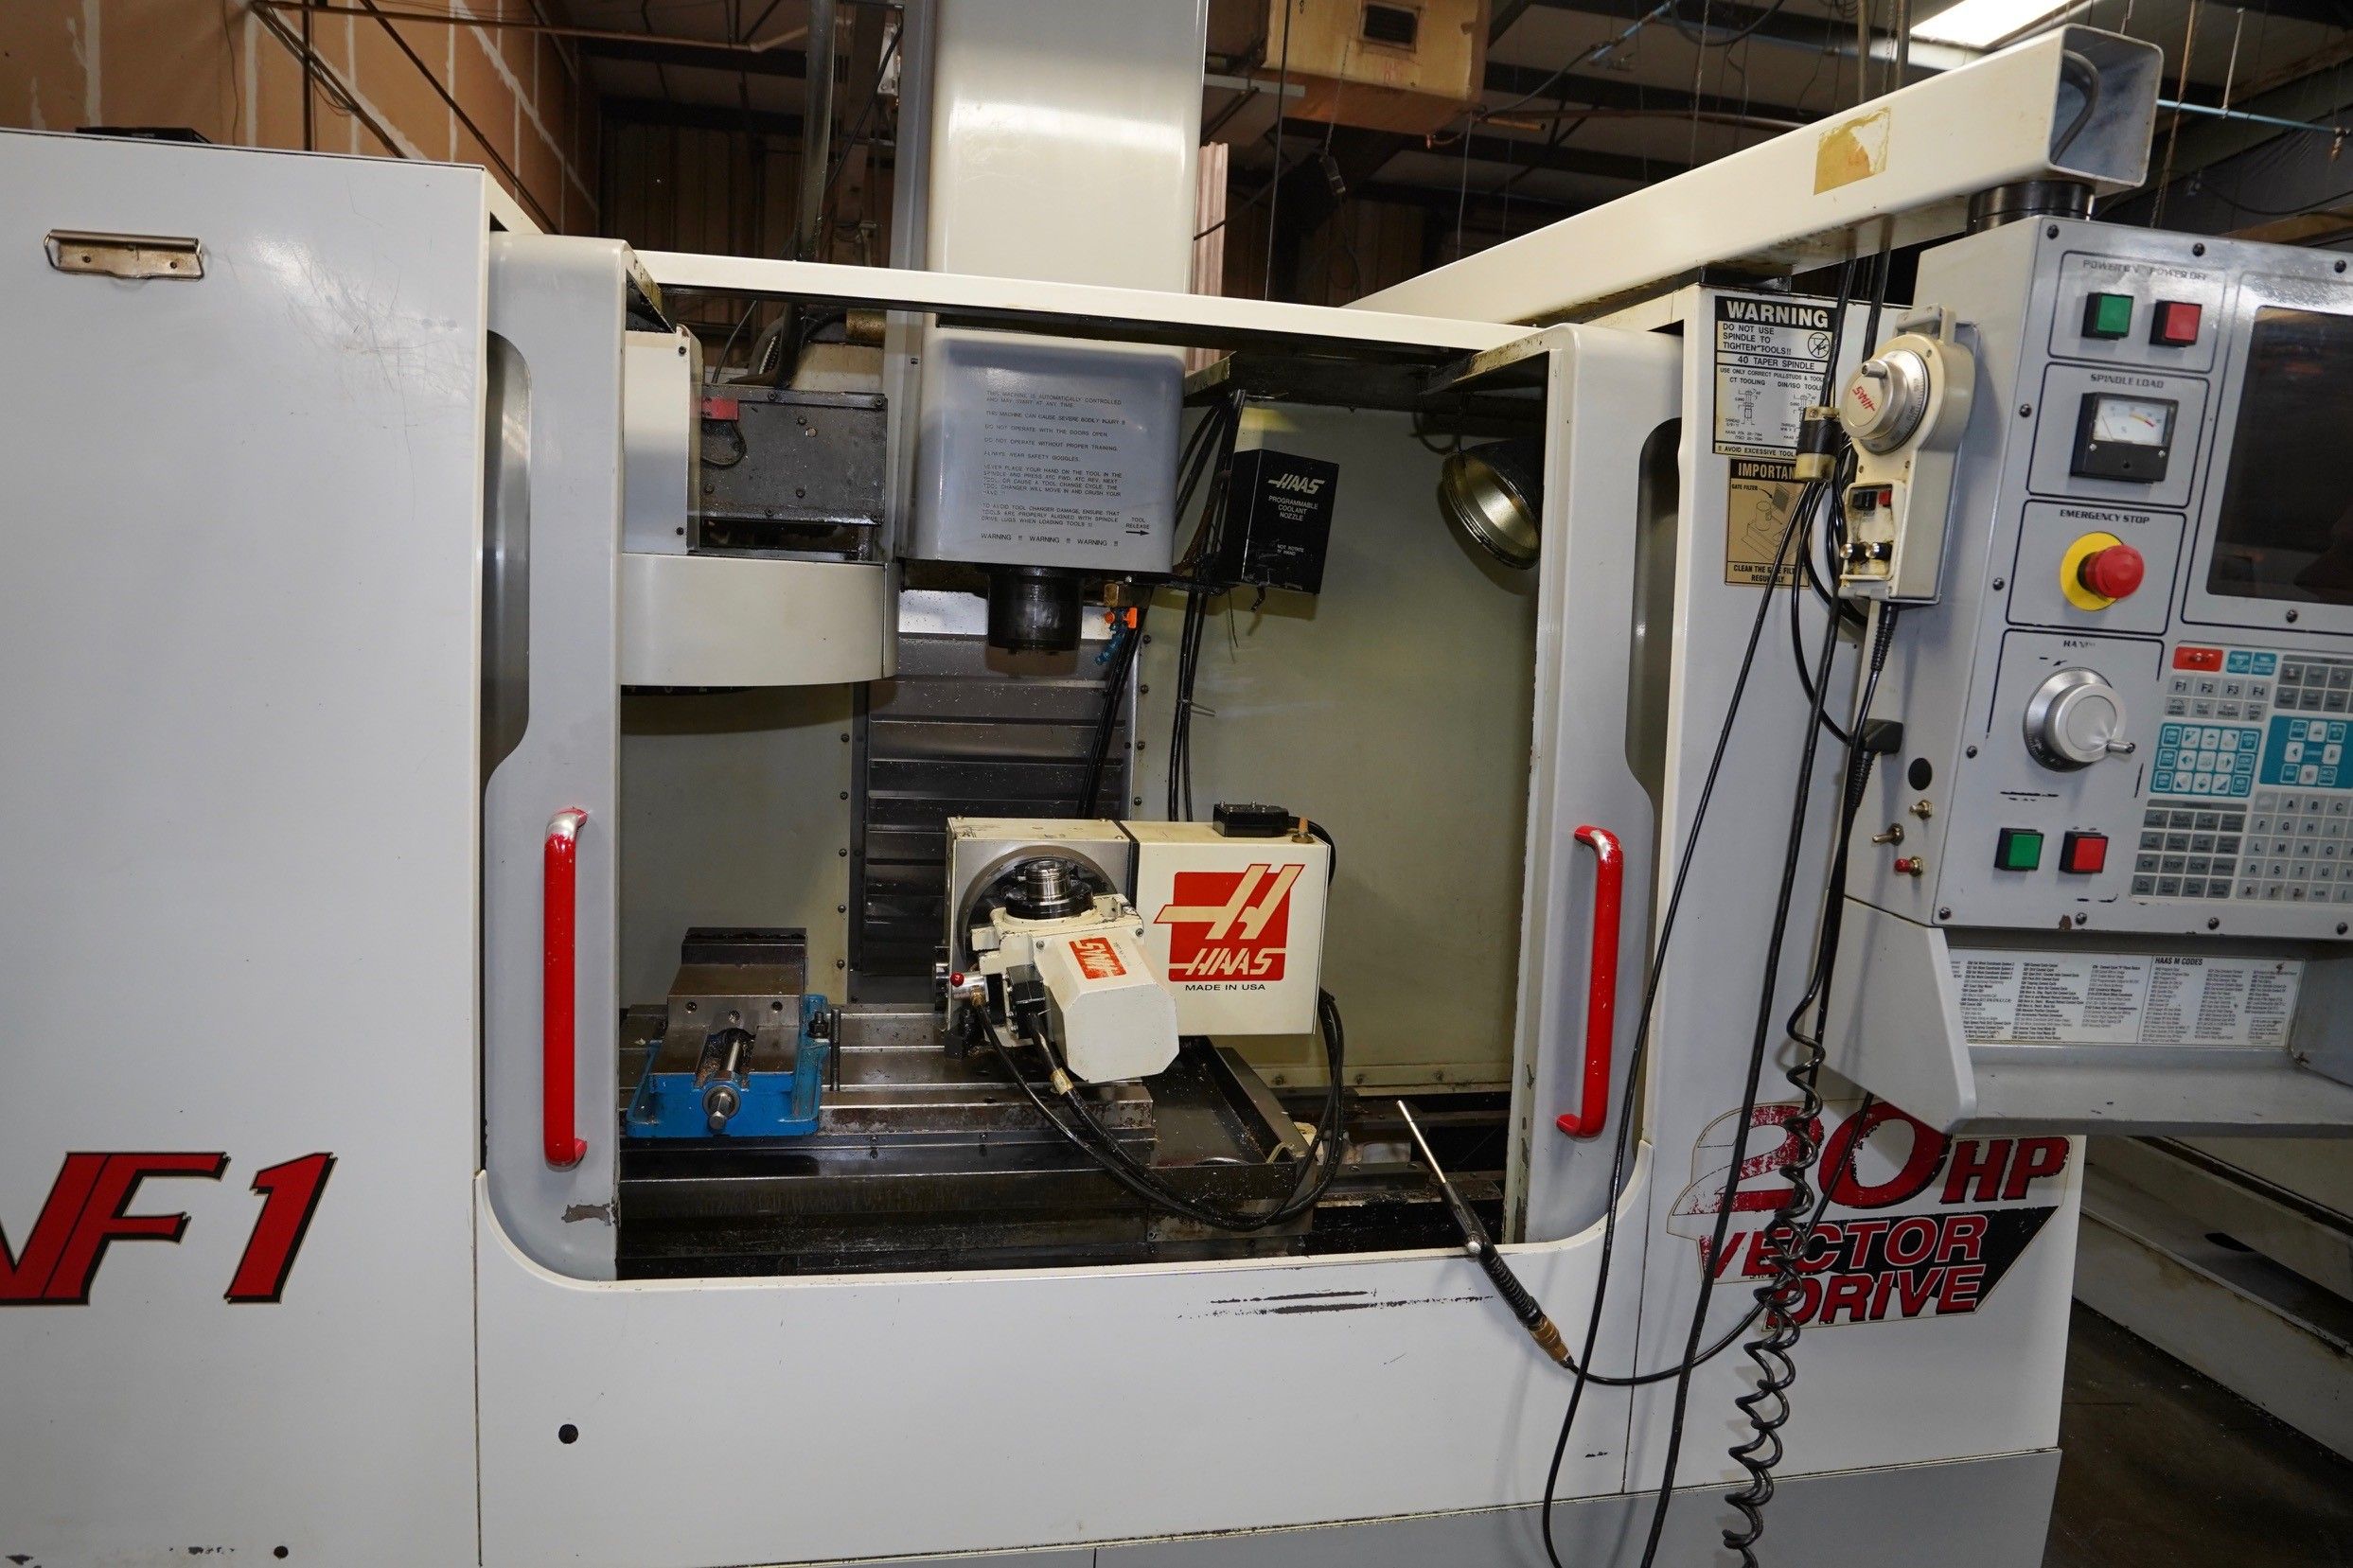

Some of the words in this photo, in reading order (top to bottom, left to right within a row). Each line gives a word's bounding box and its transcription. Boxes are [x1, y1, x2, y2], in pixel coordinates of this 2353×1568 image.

[1725, 300, 1829, 328] WARNING
[1724, 332, 1756, 343] SPINDLE
[1724, 342, 1757, 351] TIGHTEN
[1738, 356, 1748, 364] 40
[1754, 358, 1778, 367] TAPER
[1782, 360, 1814, 370] SPINDLE
[2090, 374, 2133, 385] SPINDLE
[2136, 379, 2164, 389] LOAD
[1744, 448, 1777, 456] EXCESSIVE
[1738, 463, 1796, 480] IMPORTAN
[1268, 473, 1325, 494] HAAS
[1268, 495, 1318, 510] PROGRAMMABLE
[1279, 504, 1307, 515] COOLANT
[1280, 512, 1304, 521] NOZZLE
[2060, 509, 2120, 521] EMERGENCY
[2123, 515, 2150, 523] STOP
[2175, 681, 2187, 692] F1
[2202, 682, 2214, 693] F2
[2227, 684, 2239, 695] F3
[2253, 686, 2265, 696] F4
[2288, 800, 2293, 808] A
[2311, 802, 2318, 810] B
[2335, 802, 2343, 812] C
[2259, 820, 2265, 830] F
[2282, 822, 2290, 831] G
[2307, 823, 2313, 832] H
[2255, 843, 2260, 852] L
[2278, 843, 2286, 853] M
[2302, 845, 2309, 854] N
[2249, 864, 2256, 873] R
[2273, 866, 2280, 874] S
[2322, 868, 2328, 876] U
[2245, 887, 2252, 896] X
[1169, 948, 1286, 975] HAAS
[1940, 1136, 2071, 1205] HP
[1699, 1214, 1989, 1279] VECTOR
[1765, 1263, 1986, 1329] DRIVE
